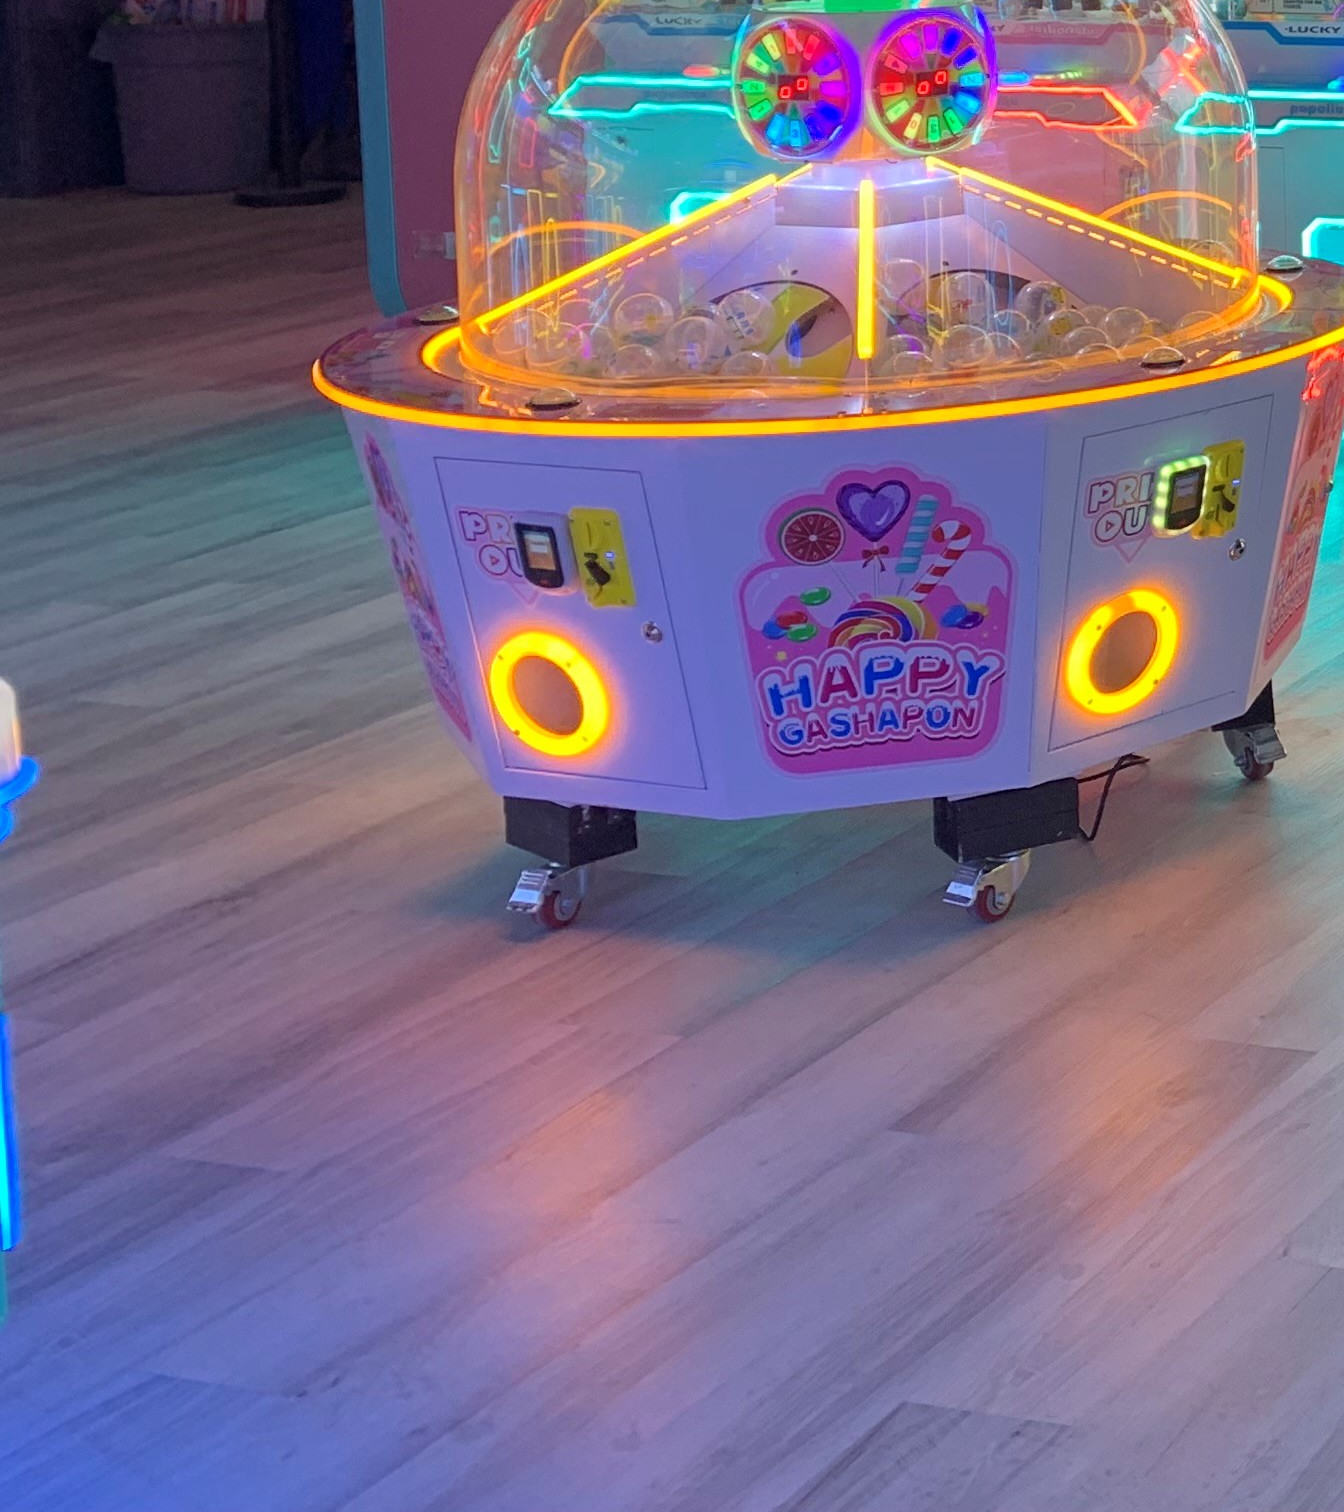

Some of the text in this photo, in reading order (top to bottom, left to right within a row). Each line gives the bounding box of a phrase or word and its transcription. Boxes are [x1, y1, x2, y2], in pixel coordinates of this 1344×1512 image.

[1088, 472, 1155, 513] PRI
[1095, 504, 1149, 542] OU
[764, 646, 1001, 720] HAPPY
[778, 698, 978, 746] GASHAPON
